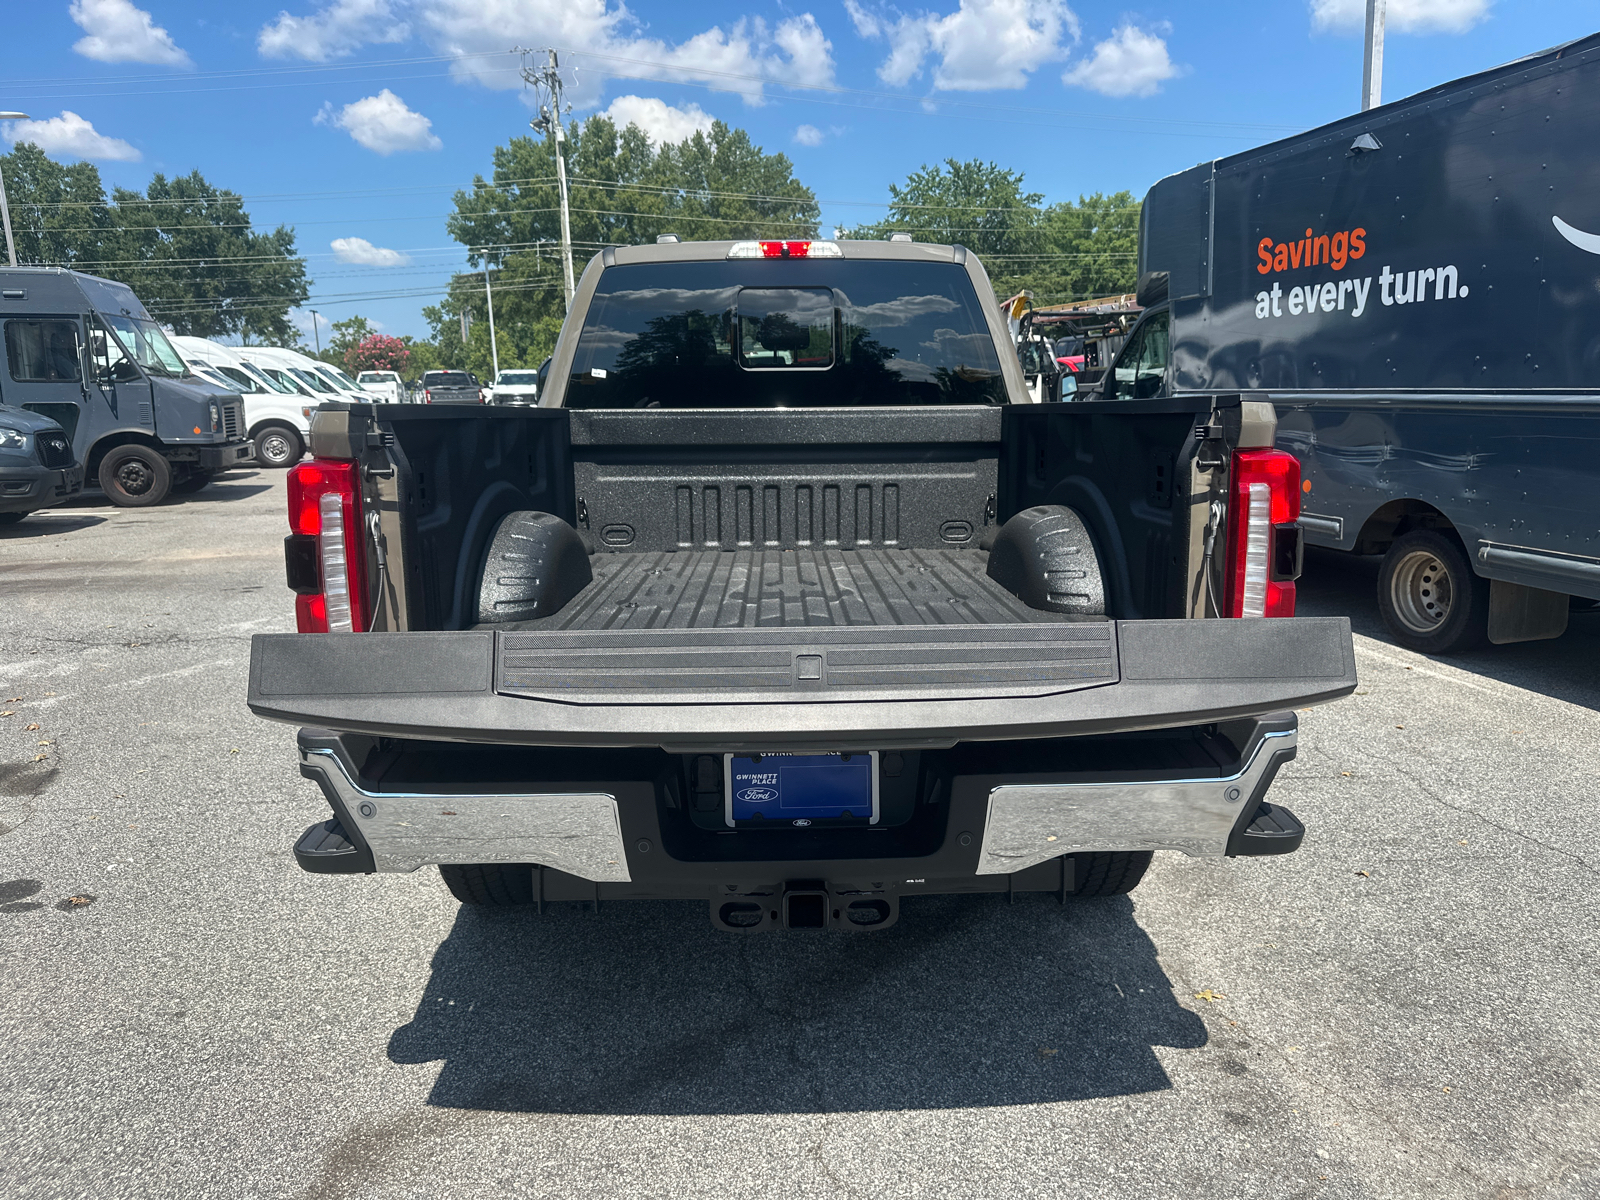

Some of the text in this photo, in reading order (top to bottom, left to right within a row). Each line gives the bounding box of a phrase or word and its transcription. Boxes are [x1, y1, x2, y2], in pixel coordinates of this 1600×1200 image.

[1257, 228, 1366, 275] Savings
[1255, 264, 1469, 319] at every turn.
[744, 789, 771, 800] Ford
